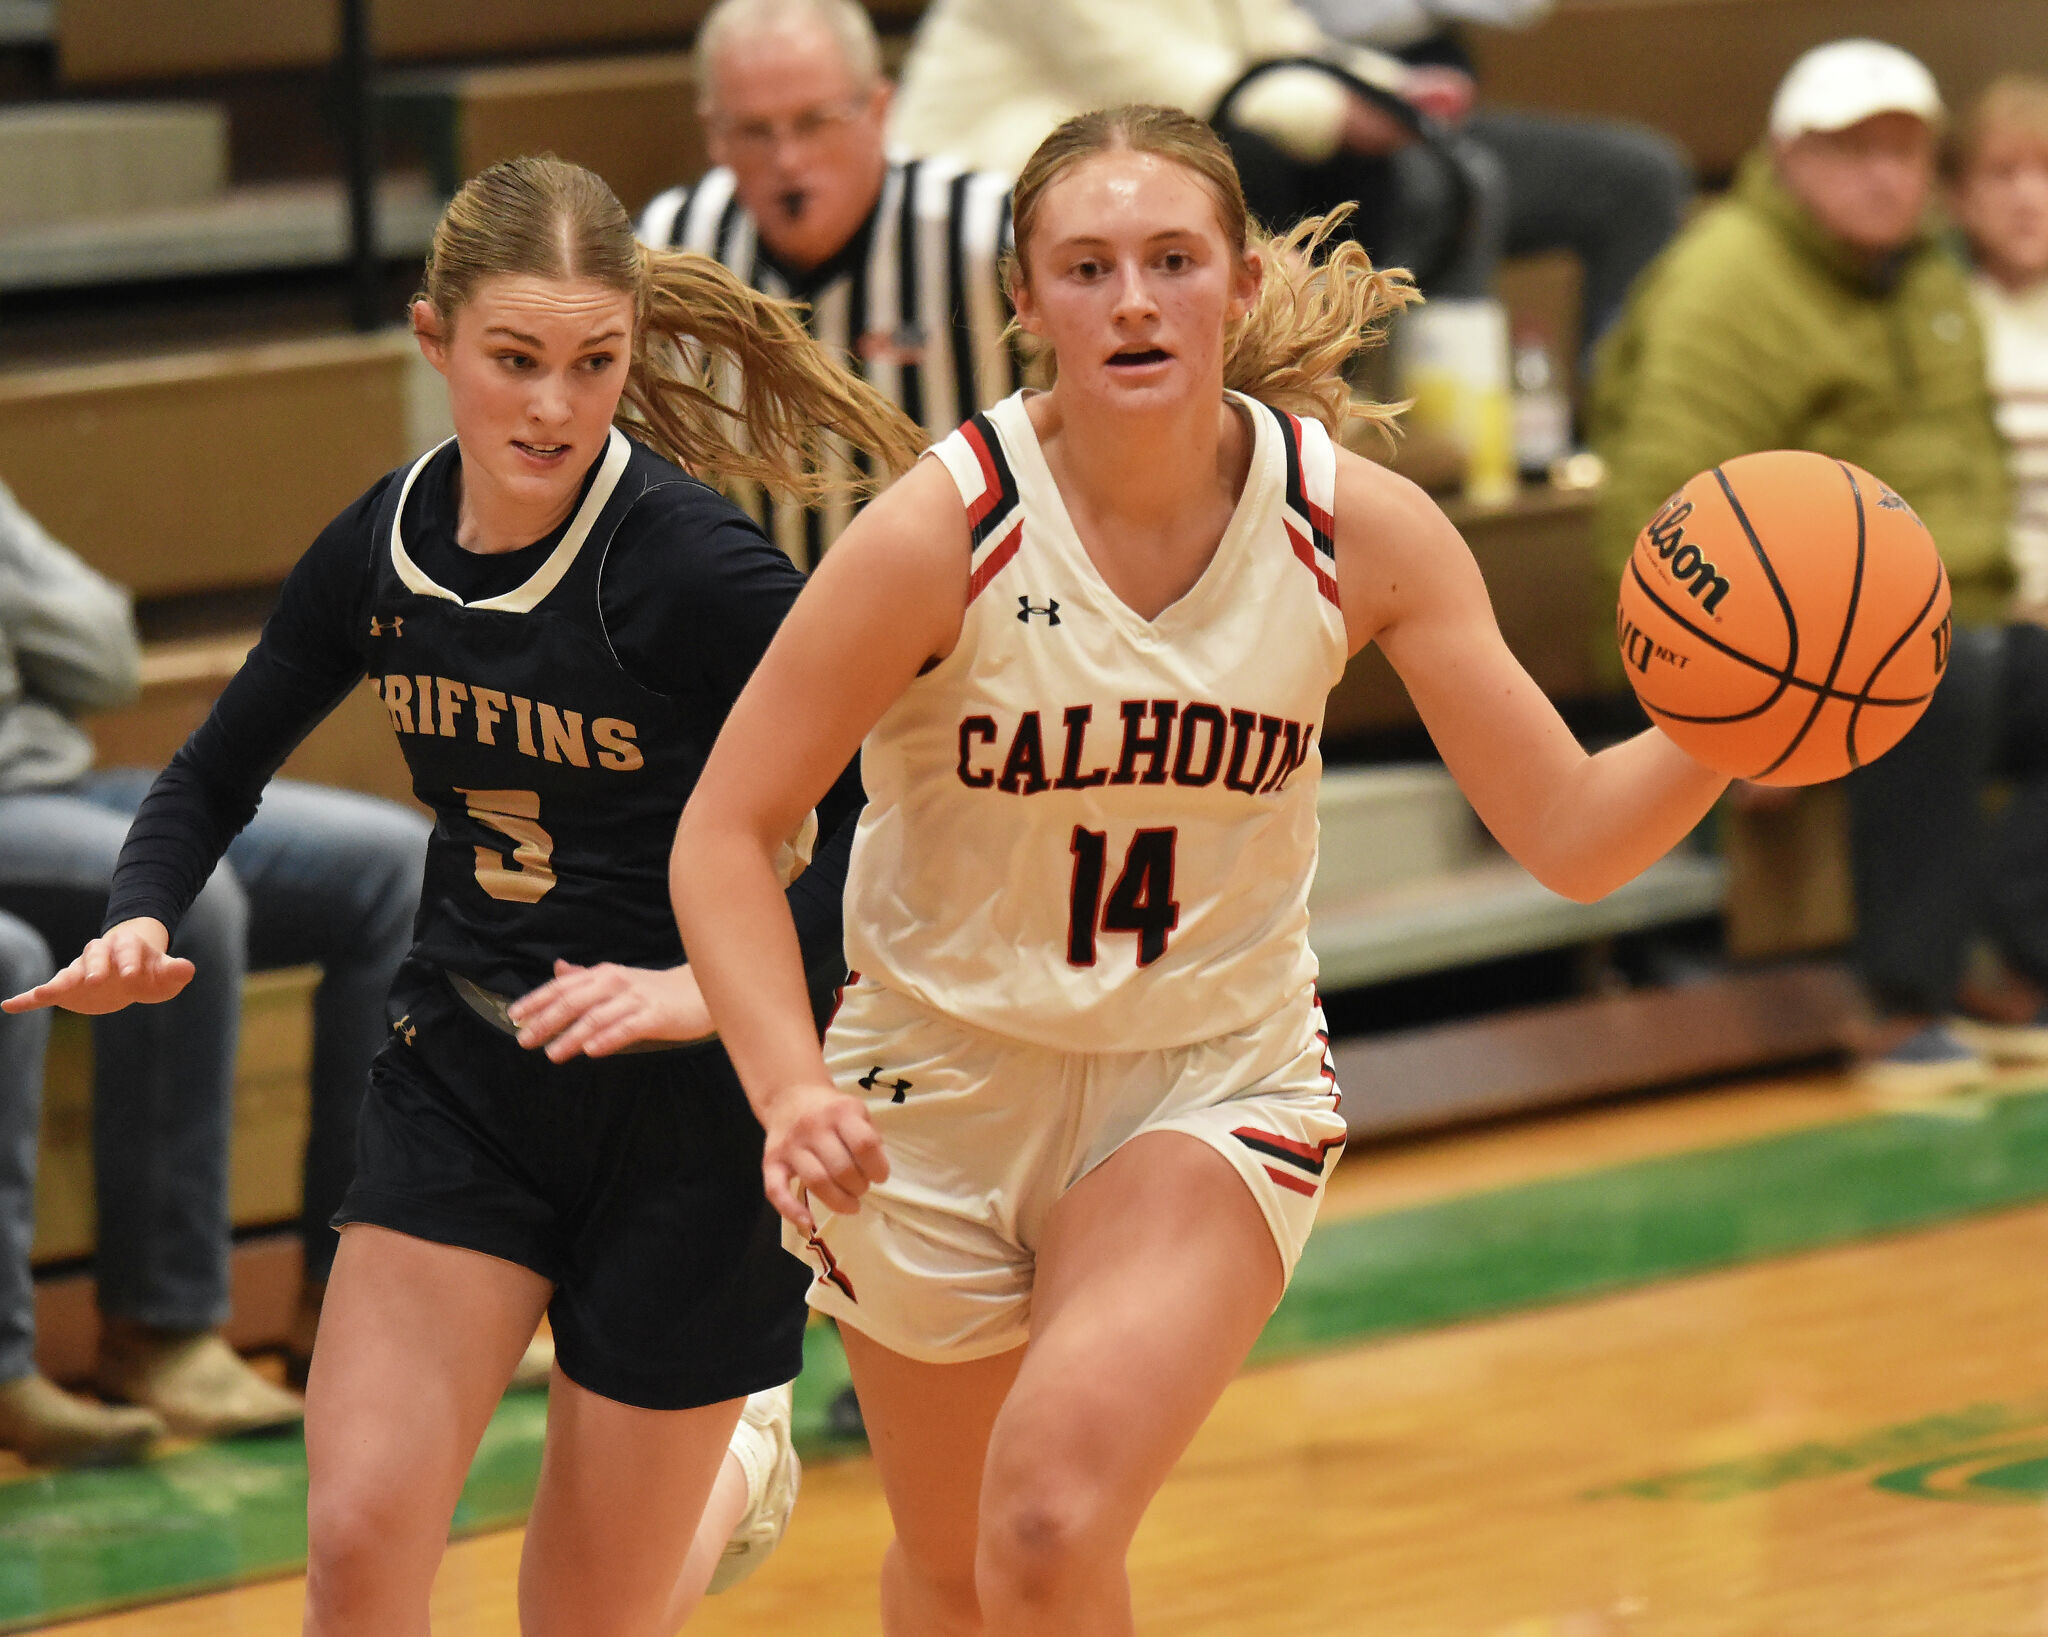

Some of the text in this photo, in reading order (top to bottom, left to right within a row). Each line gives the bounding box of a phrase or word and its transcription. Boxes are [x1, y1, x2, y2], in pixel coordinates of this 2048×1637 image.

[1647, 489, 1730, 618] ilson
[1656, 646, 1691, 669] NXT
[369, 674, 644, 771] RIFFINS
[1067, 824, 1180, 968] 14
